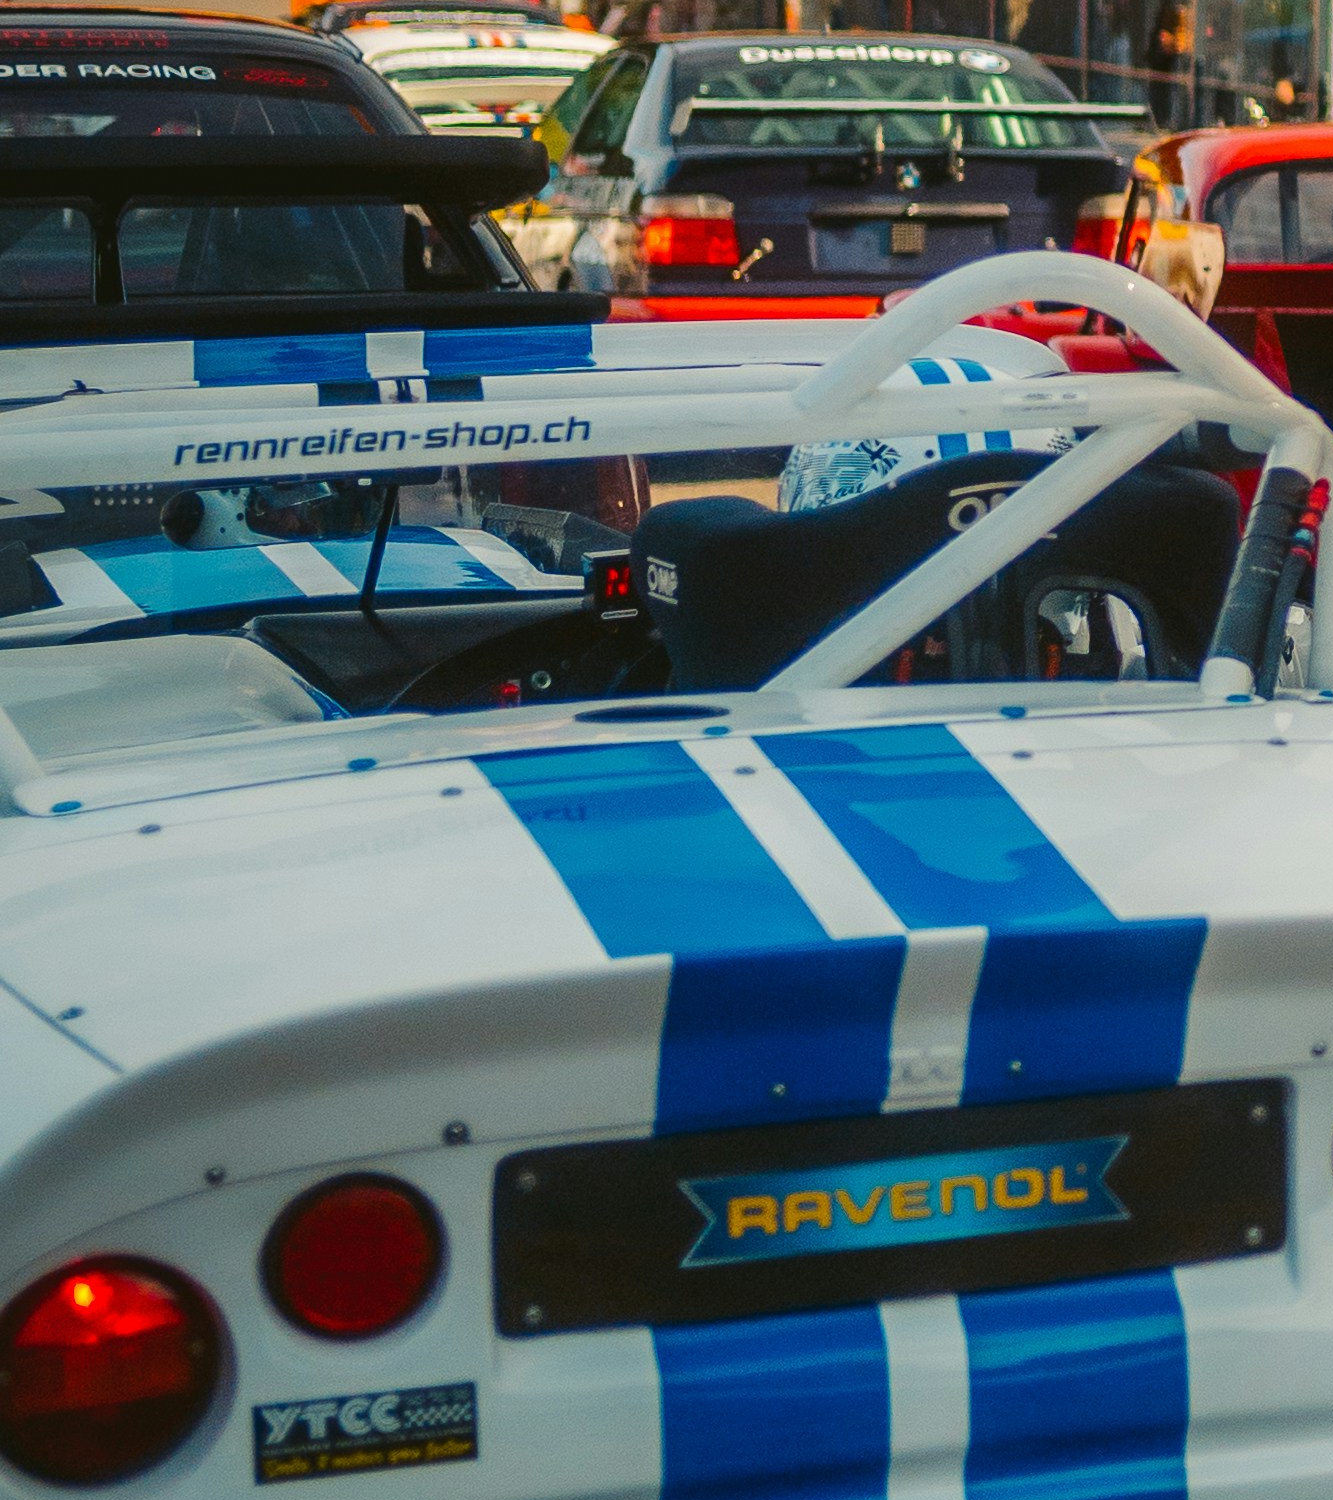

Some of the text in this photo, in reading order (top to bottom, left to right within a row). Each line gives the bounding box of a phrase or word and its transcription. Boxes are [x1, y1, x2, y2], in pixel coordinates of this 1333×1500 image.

[78, 64, 216, 81] RACING
[174, 416, 591, 465] rennreifen-shop.ch
[726, 1166, 1089, 1239] RAVENOL
[261, 1394, 402, 1446] YTCC
